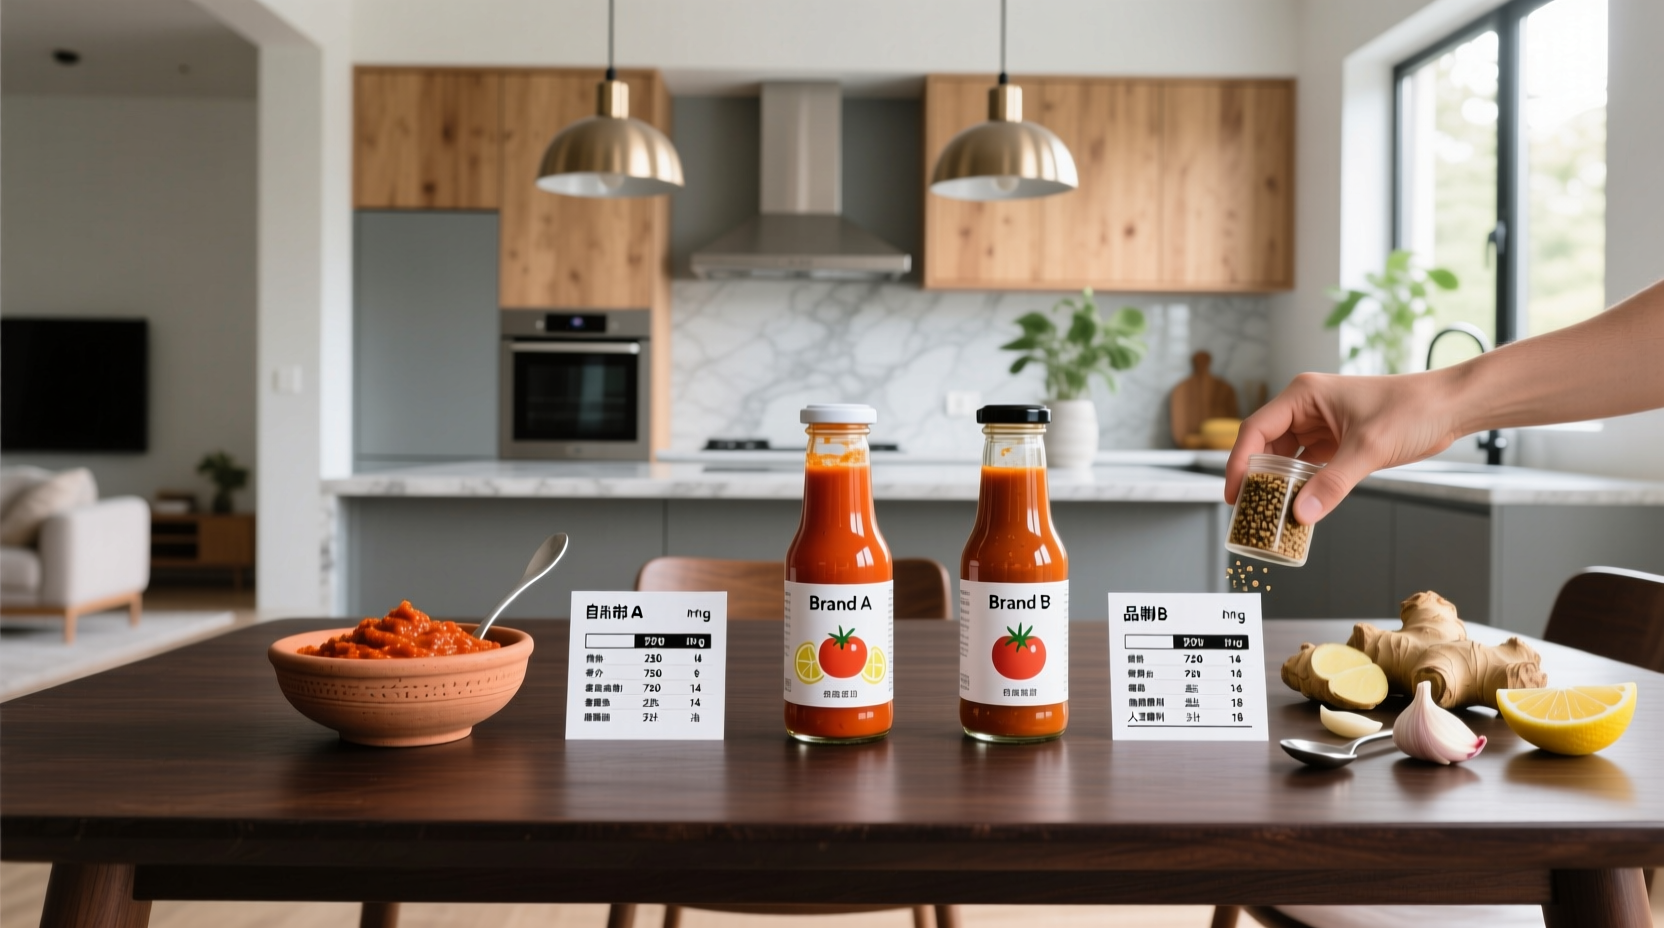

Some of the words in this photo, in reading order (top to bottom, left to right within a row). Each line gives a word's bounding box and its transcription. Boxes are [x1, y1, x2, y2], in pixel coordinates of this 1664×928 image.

[809, 595, 857, 611] Brand
[860, 595, 872, 611] A
[989, 594, 1036, 610] Brand
[1040, 594, 1051, 610] B
